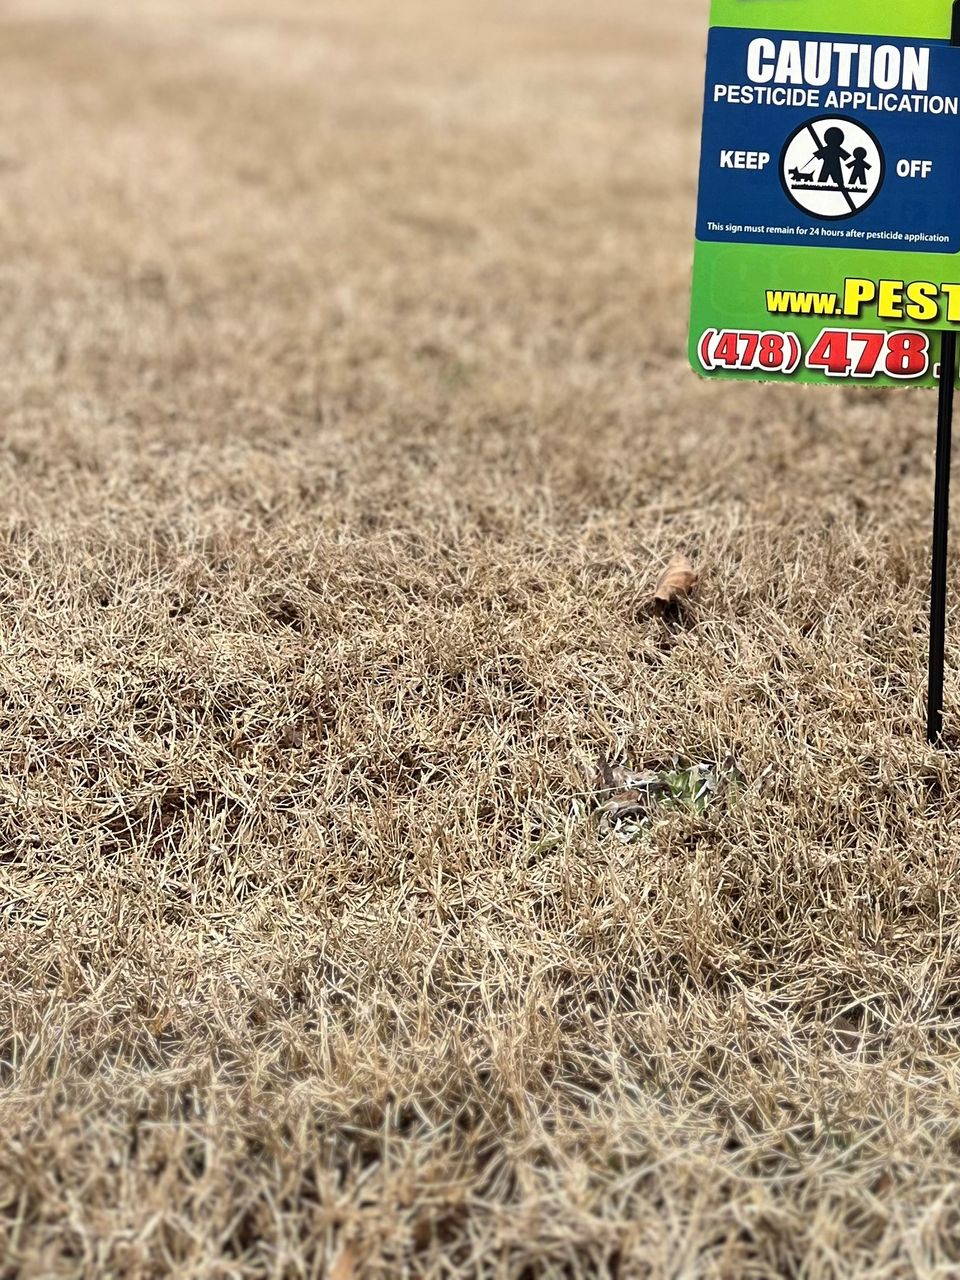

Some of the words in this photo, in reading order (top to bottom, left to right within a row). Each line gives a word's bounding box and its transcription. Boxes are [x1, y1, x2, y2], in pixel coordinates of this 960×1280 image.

[746, 37, 930, 91] CAUTION
[713, 84, 820, 107] PESTICIDE
[824, 90, 959, 115] APPLICATION
[719, 149, 770, 170] KEEP
[896, 159, 933, 178] OFF
[707, 222, 724, 231] This
[725, 223, 743, 233] sign
[744, 225, 765, 234] must
[766, 227, 795, 235] remain
[796, 227, 808, 236] for
[809, 227, 820, 236] 24
[821, 228, 844, 238] hours
[846, 229, 865, 239] after
[866, 231, 903, 241] pesticide
[904, 233, 950, 243] application
[698, 328, 801, 374] (478)
